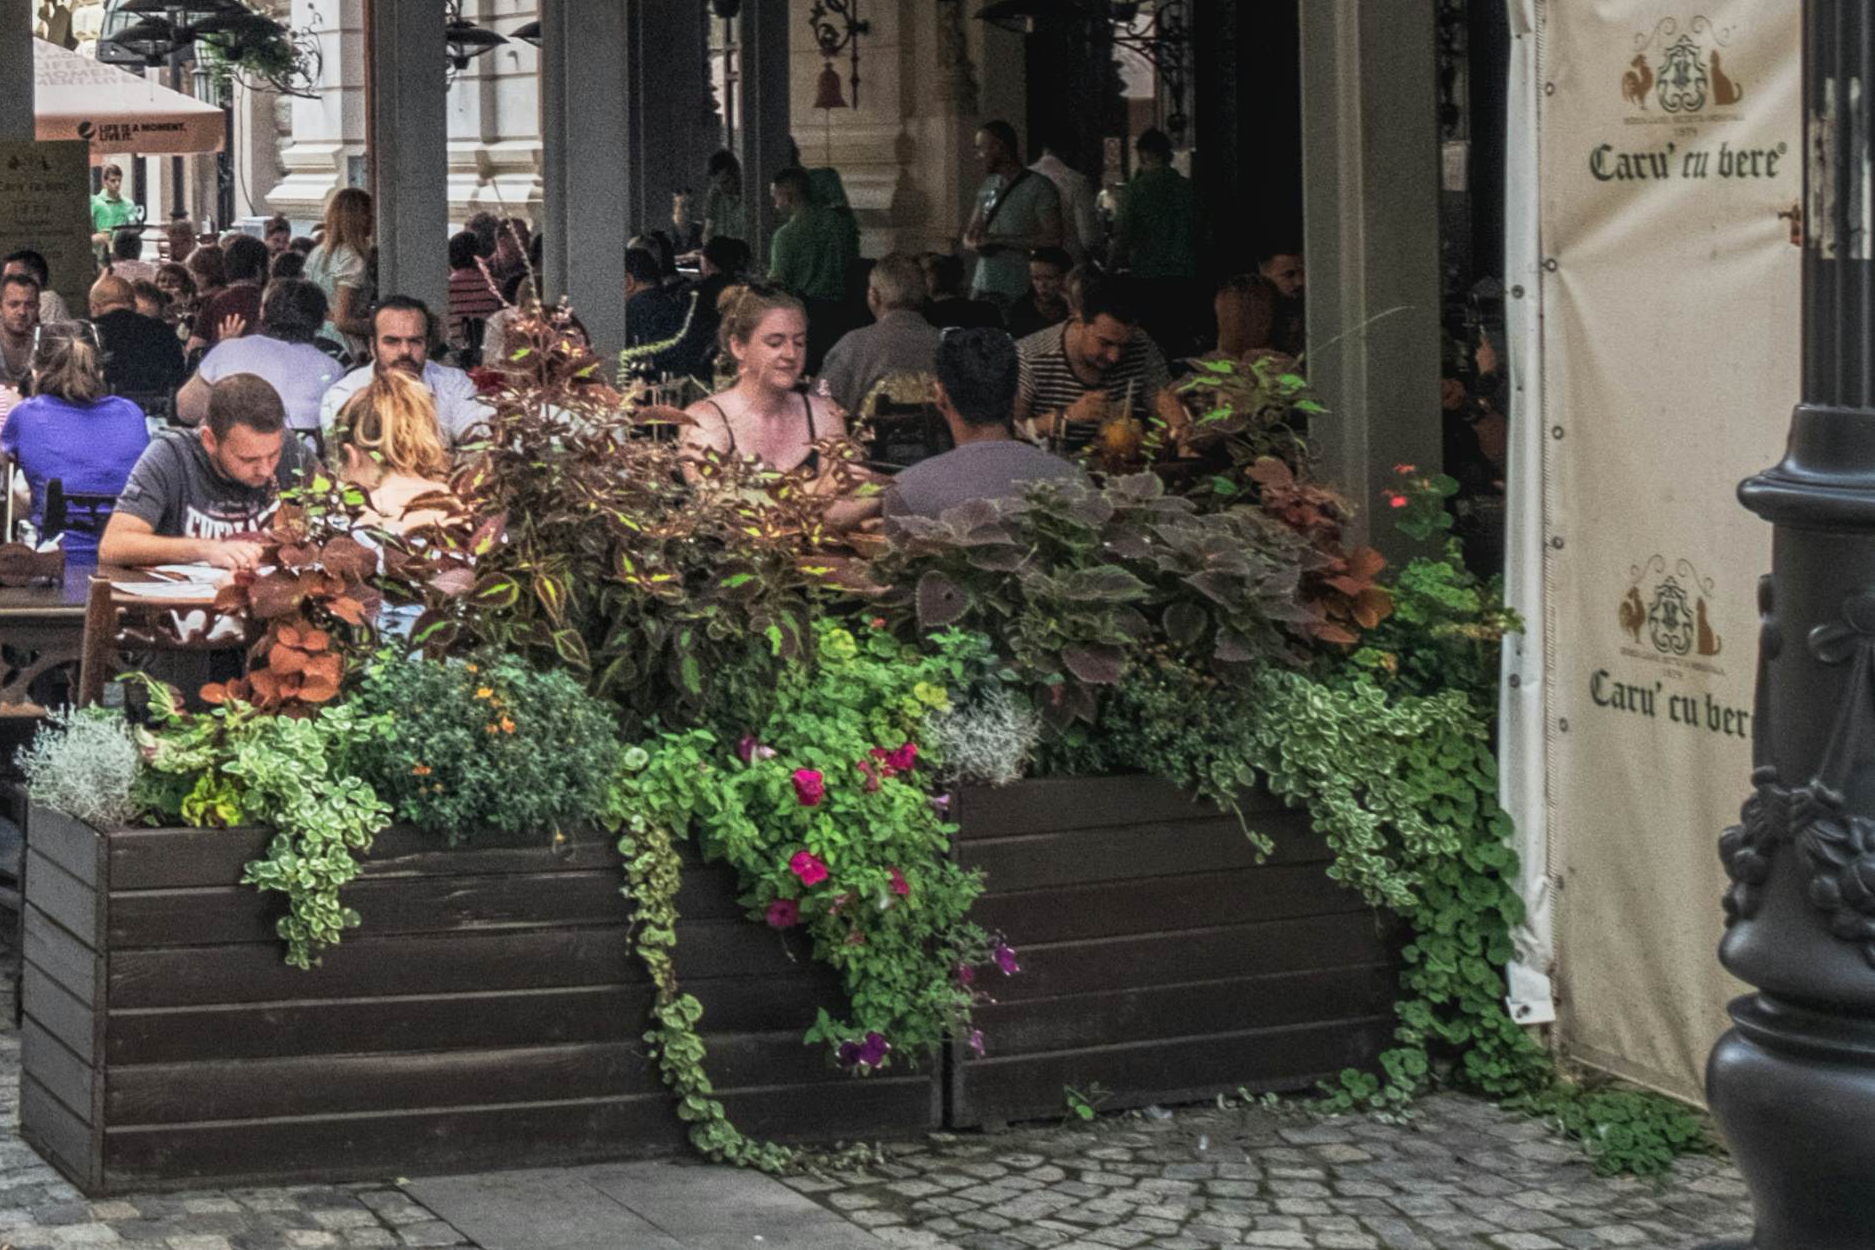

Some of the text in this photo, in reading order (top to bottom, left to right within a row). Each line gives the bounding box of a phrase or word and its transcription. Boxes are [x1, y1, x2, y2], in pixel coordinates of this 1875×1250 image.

[1590, 142, 1675, 181] Caru'
[1681, 151, 1709, 179] cu
[1590, 669, 1754, 738] Caru' cu ber
